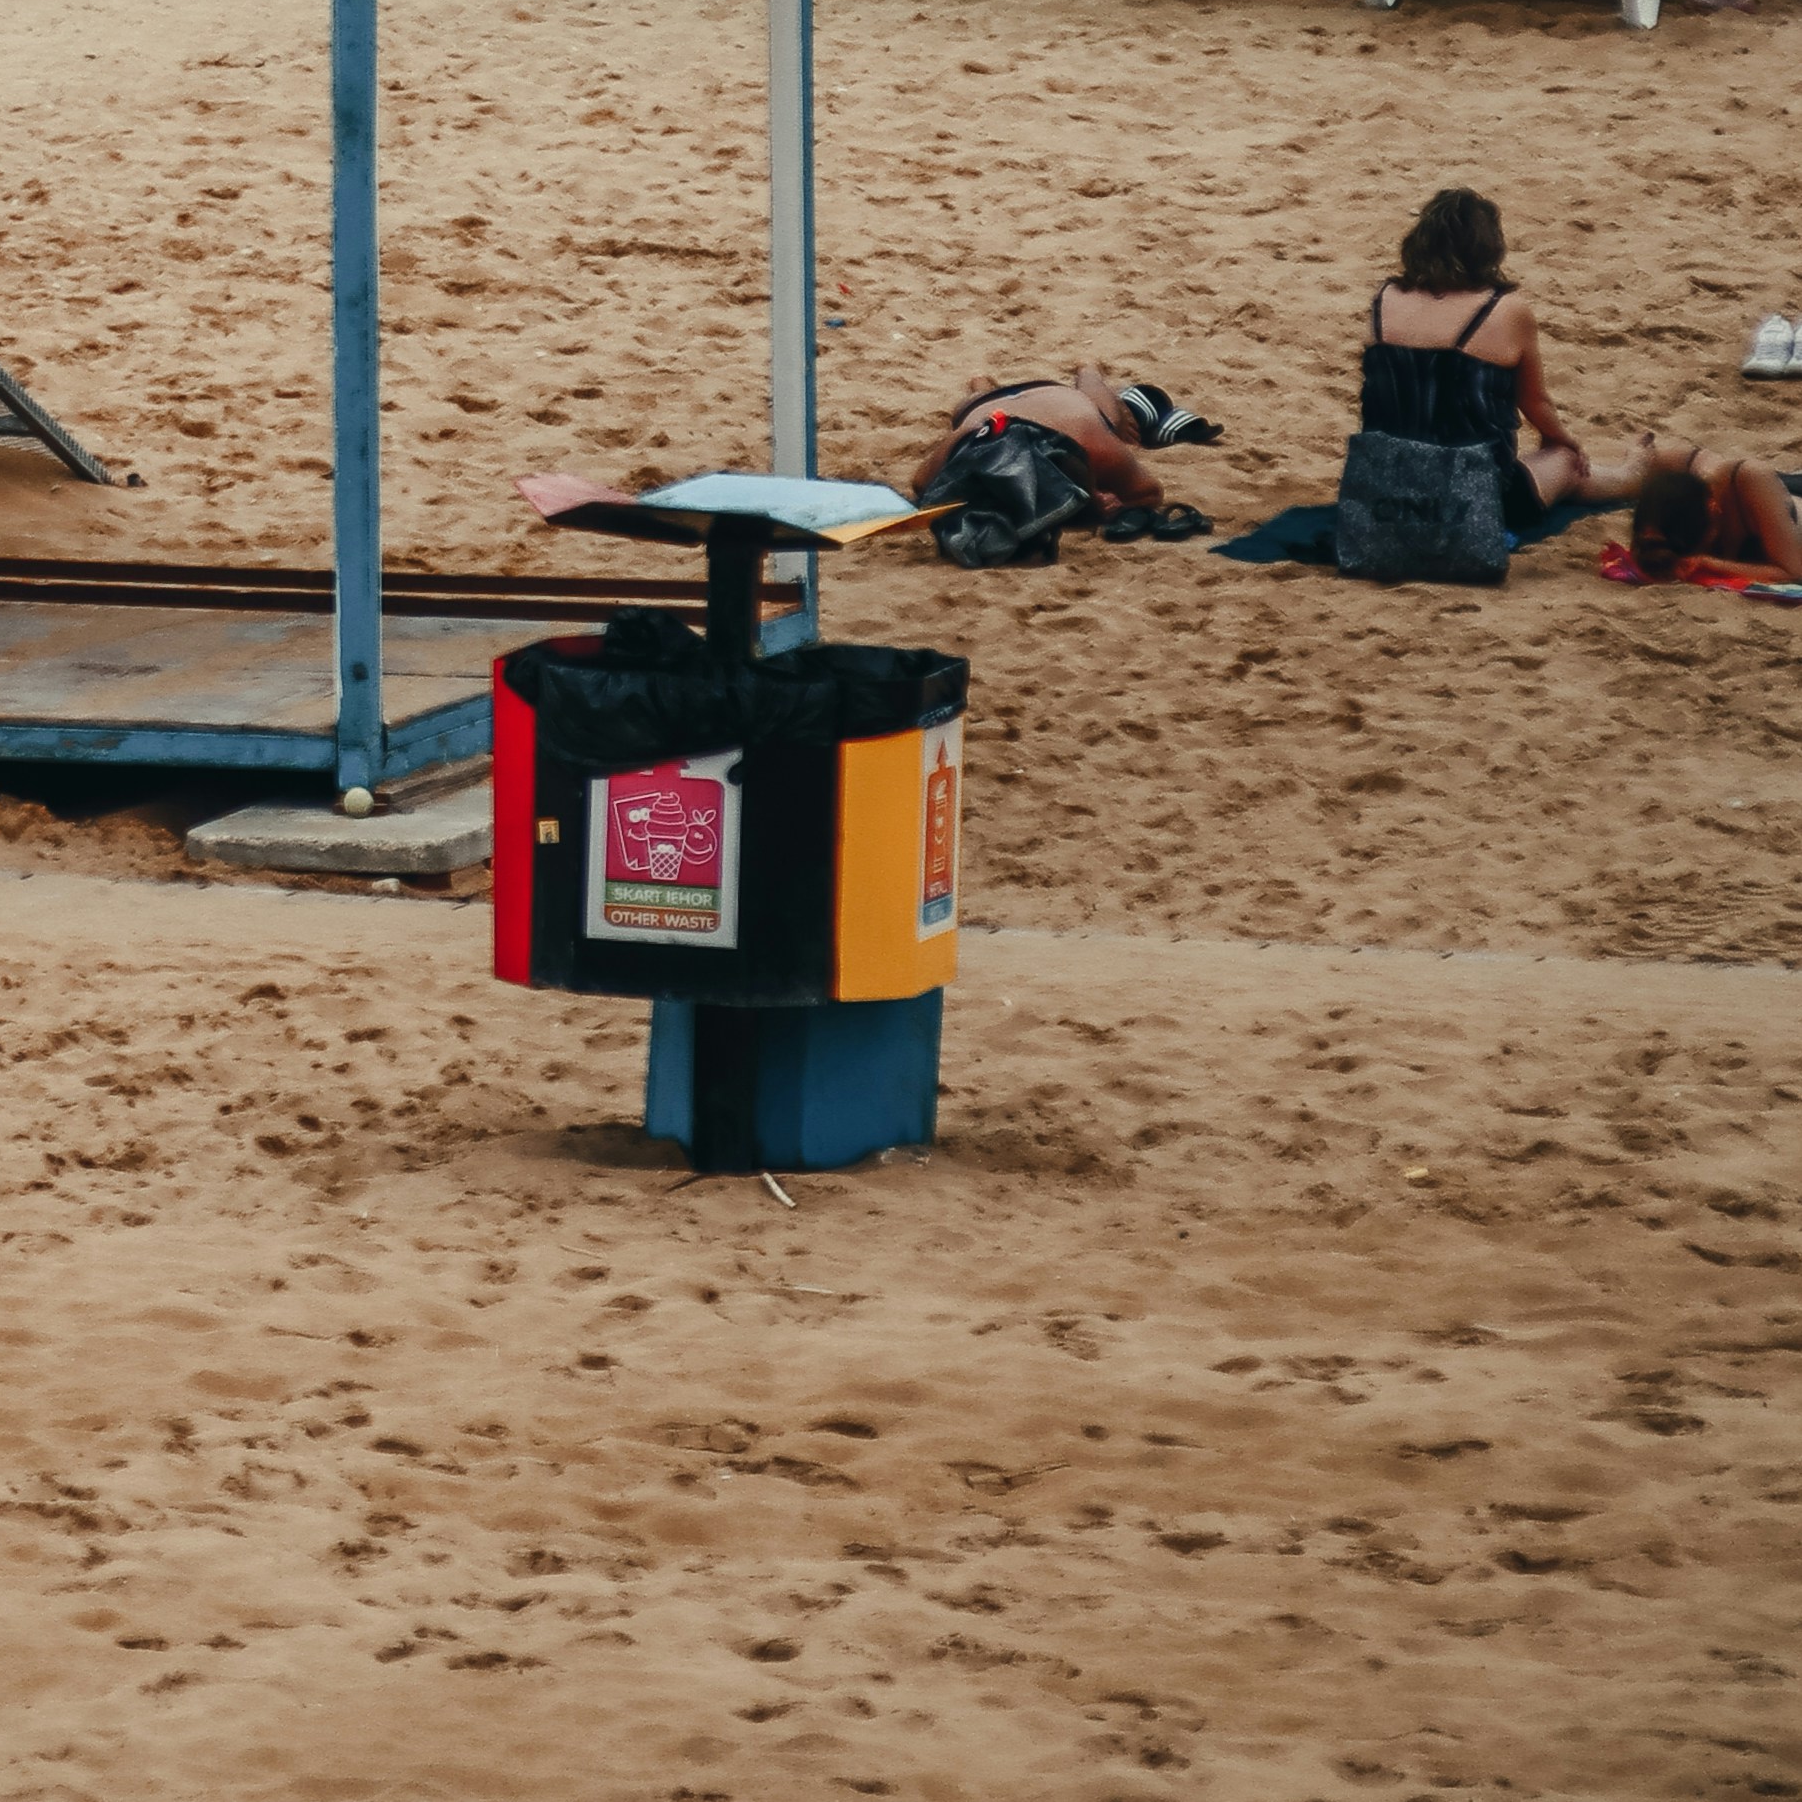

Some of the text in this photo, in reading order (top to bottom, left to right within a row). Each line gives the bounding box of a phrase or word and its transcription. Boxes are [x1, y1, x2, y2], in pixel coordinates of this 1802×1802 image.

[613, 886, 662, 903] SKART
[610, 910, 715, 930] OTHER WASTE
